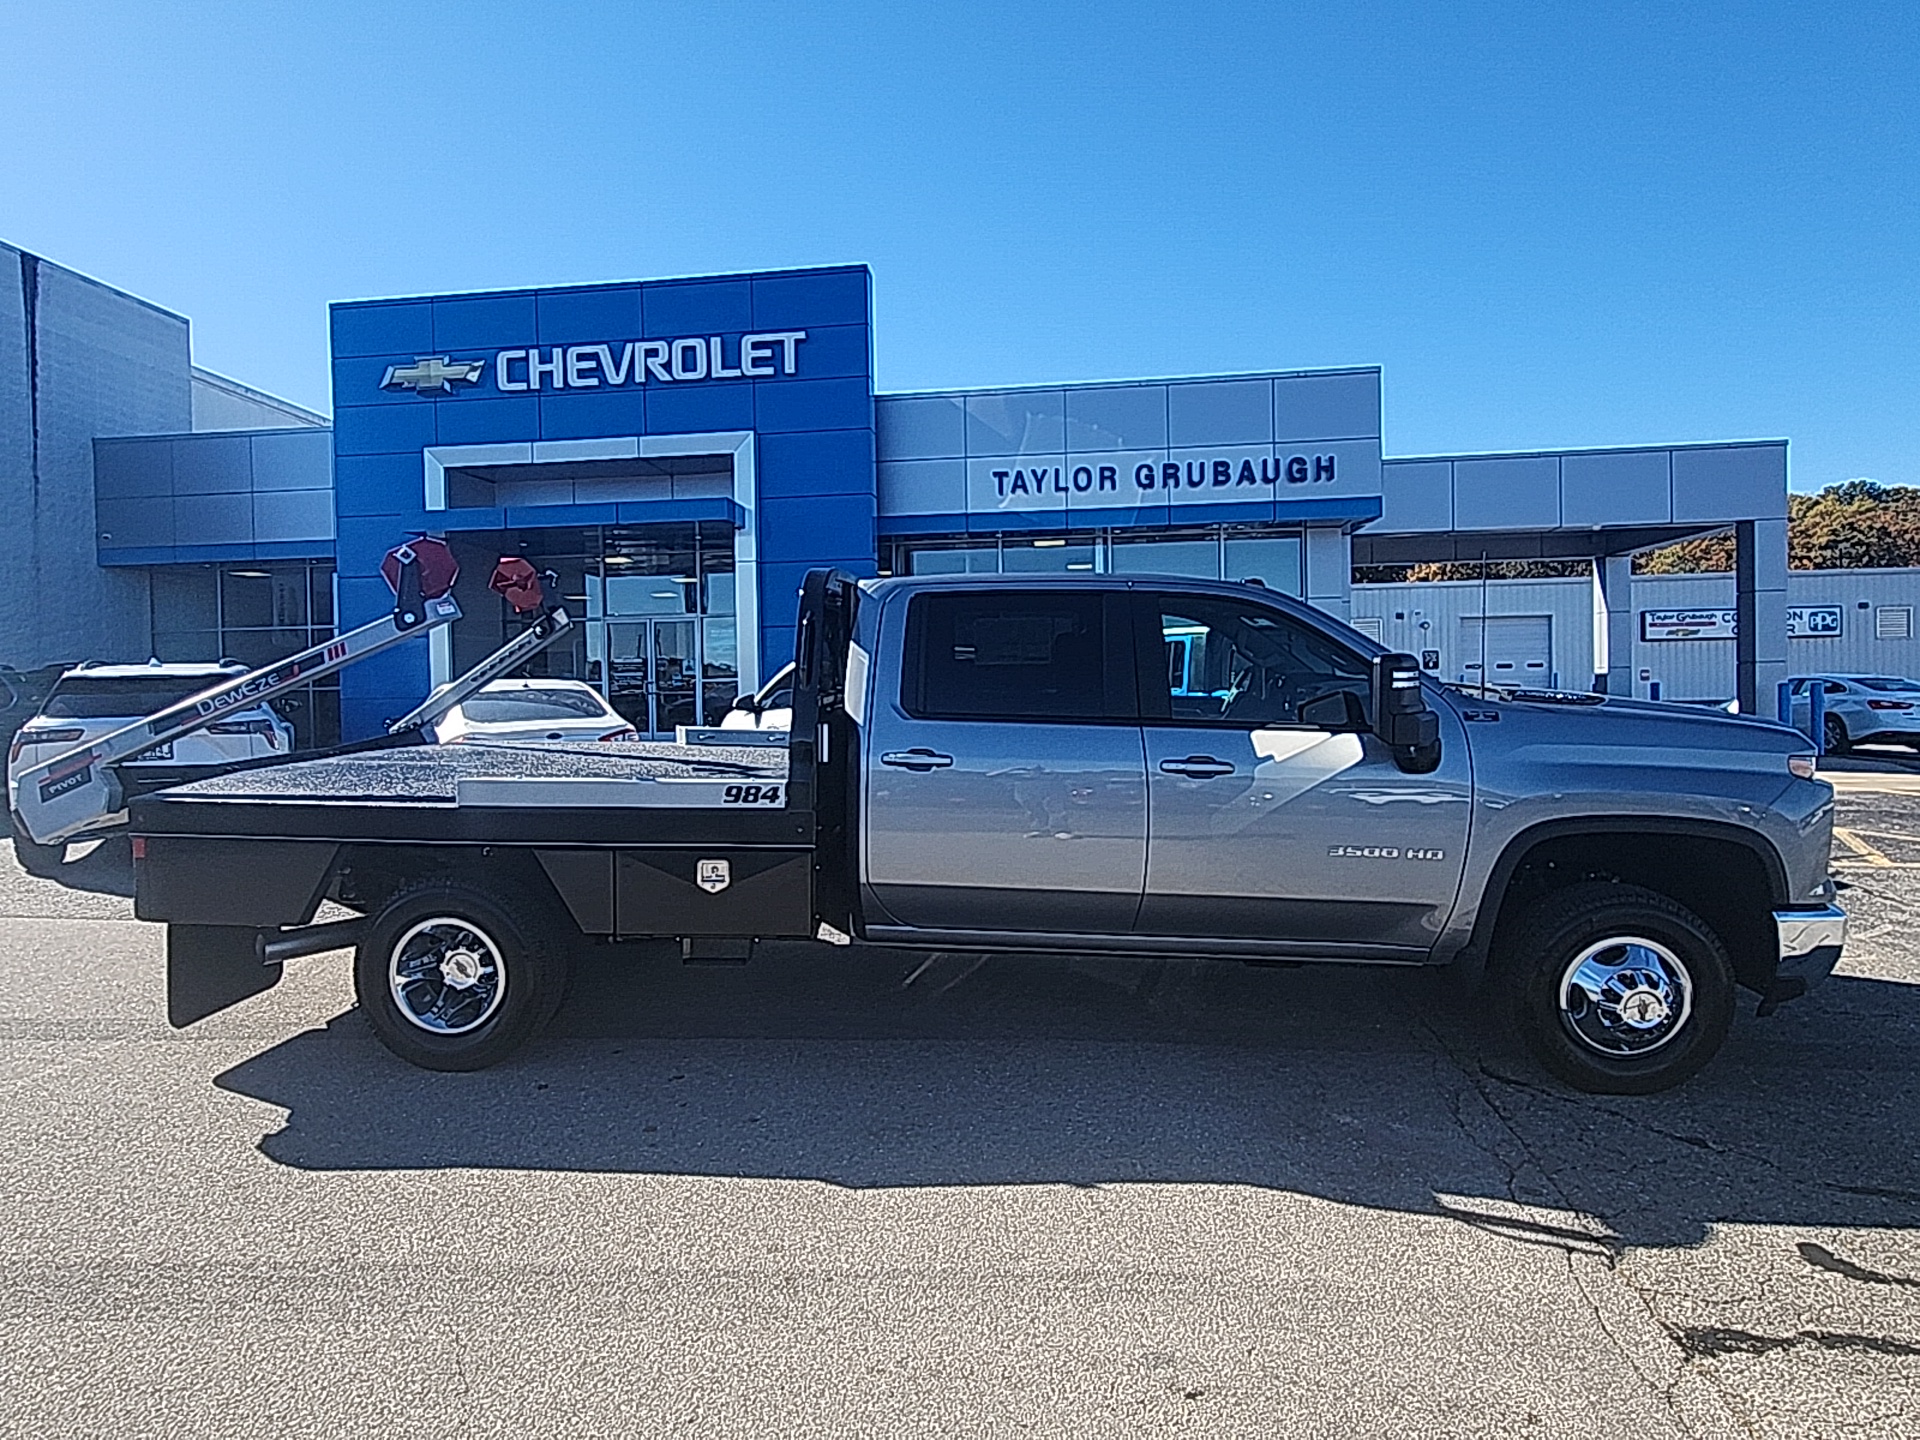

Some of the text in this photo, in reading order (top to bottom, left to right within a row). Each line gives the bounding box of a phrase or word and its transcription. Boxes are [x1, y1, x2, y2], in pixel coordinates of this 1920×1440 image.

[496, 330, 806, 392] CHEVROLET
[992, 455, 1336, 497] TAYLOR GRUBAUGH
[1810, 612, 1837, 630] PPG
[48, 773, 83, 794] PIVOT
[722, 785, 780, 804] 984
[1328, 845, 1444, 861] 3500 HD
